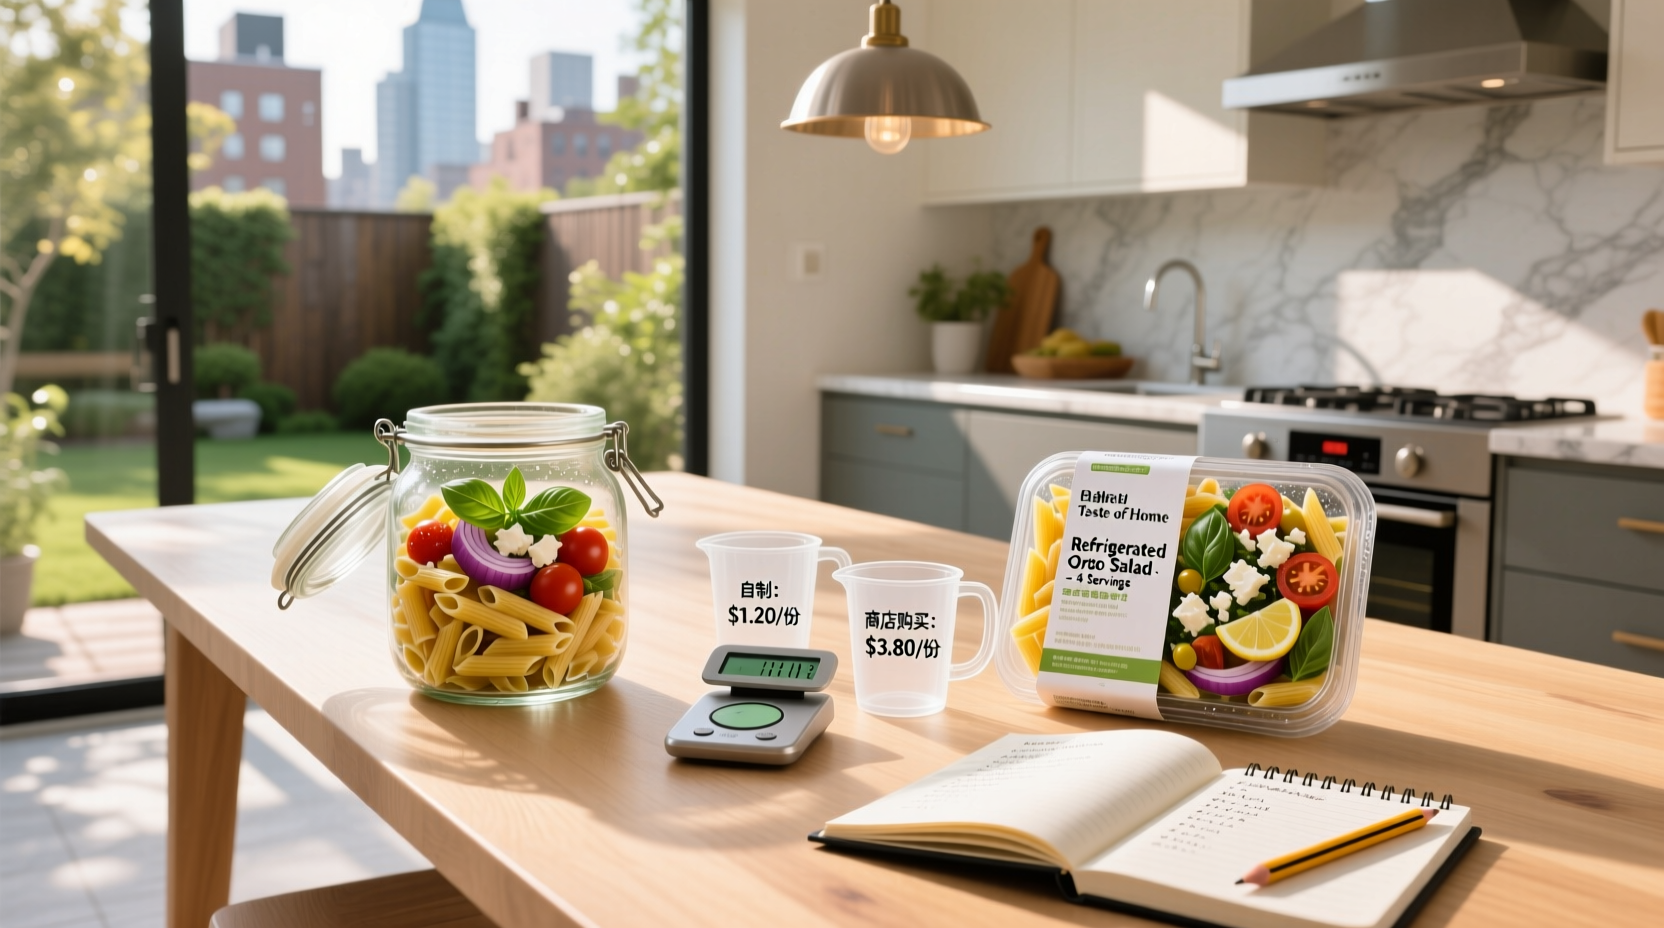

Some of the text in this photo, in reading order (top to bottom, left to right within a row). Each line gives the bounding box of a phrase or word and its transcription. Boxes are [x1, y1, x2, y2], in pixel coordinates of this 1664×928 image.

[1078, 504, 1169, 523] Taste of Home
[1071, 536, 1167, 558] Refrigerated
[740, 580, 780, 600] 自制：
[1076, 573, 1083, 583] 4
[1087, 573, 1131, 591] Servings
[728, 604, 801, 626] $1.20/份
[864, 609, 936, 631] 商店购买：
[865, 634, 941, 660] $3.80/份
